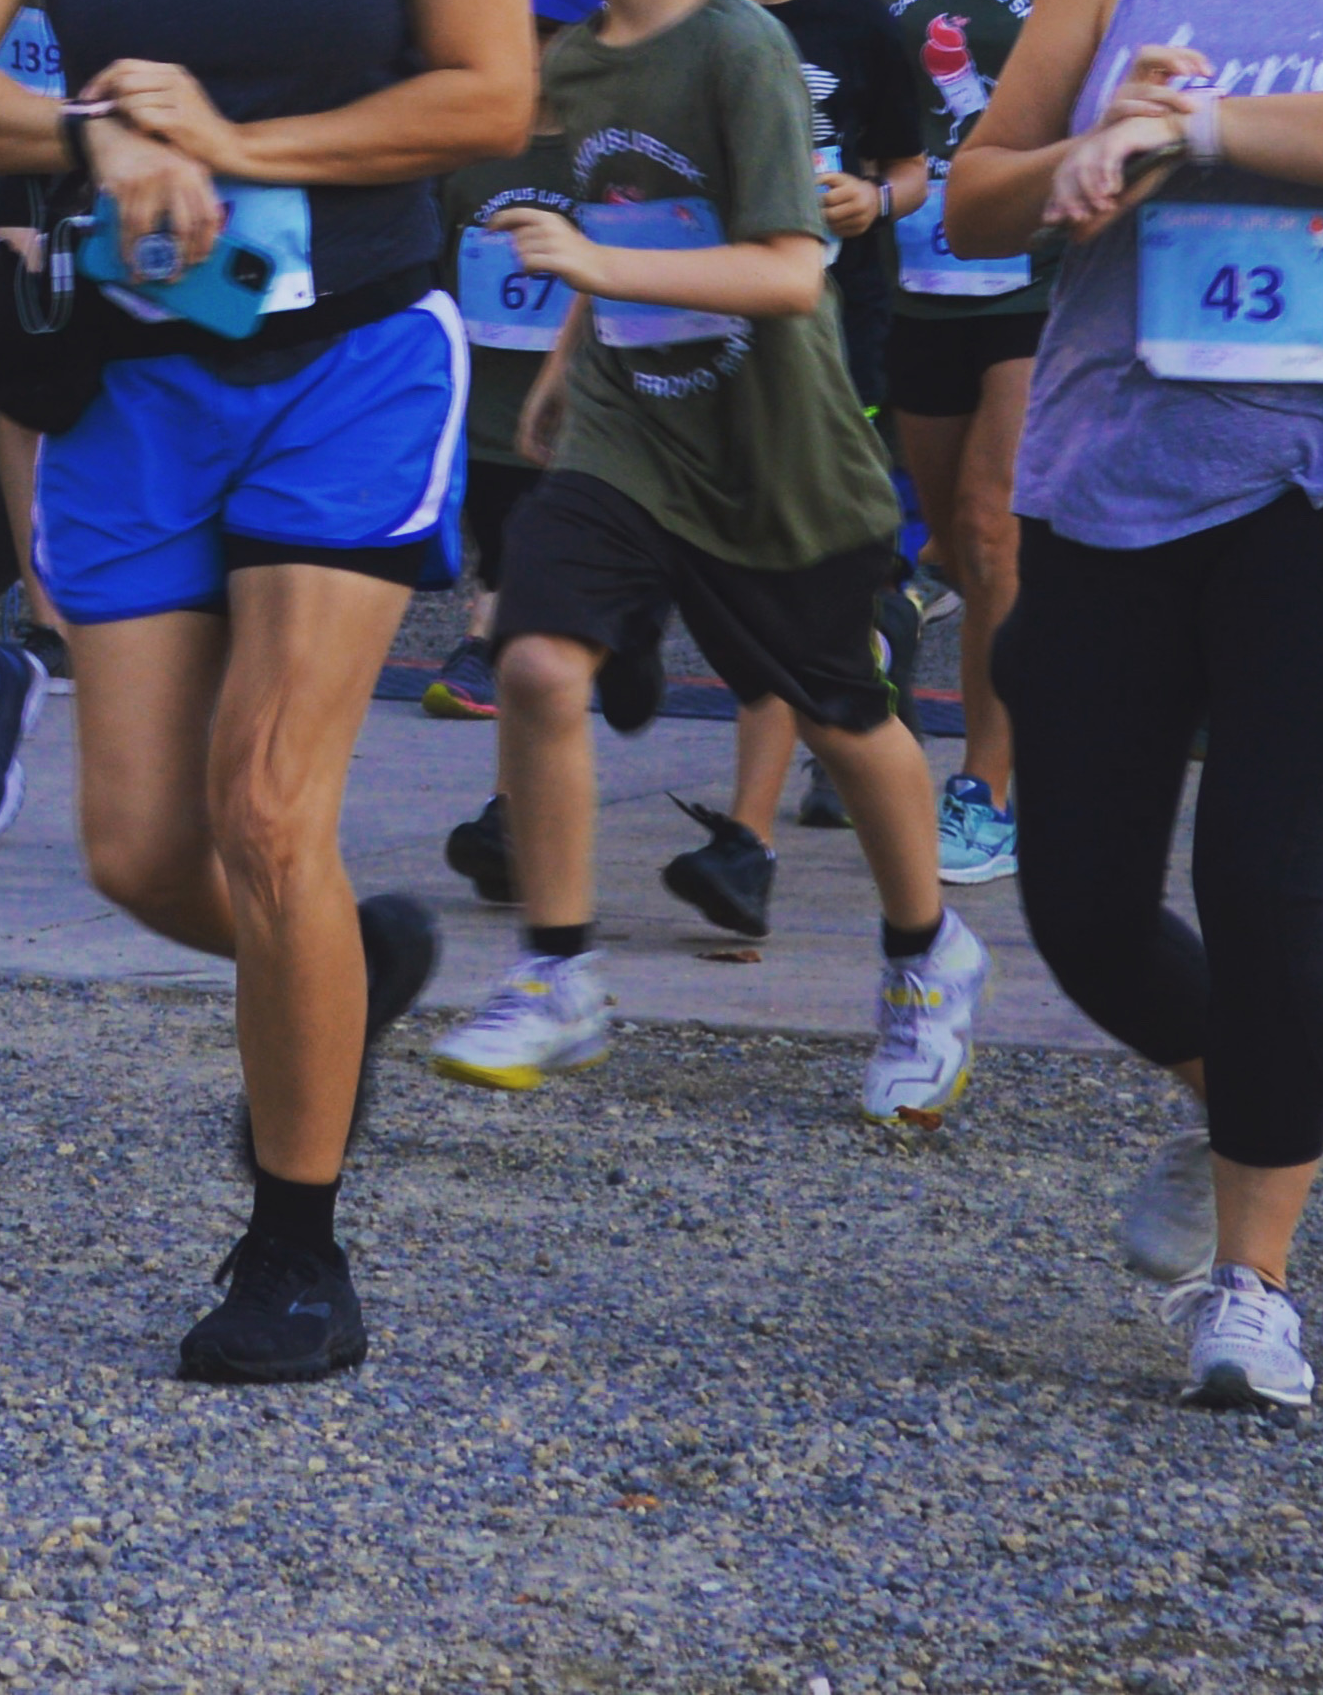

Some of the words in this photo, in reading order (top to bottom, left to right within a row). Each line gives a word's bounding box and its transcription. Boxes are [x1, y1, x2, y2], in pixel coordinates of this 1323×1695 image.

[10, 40, 62, 76] 139
[501, 271, 558, 311] 67
[1200, 262, 1286, 322] 43
